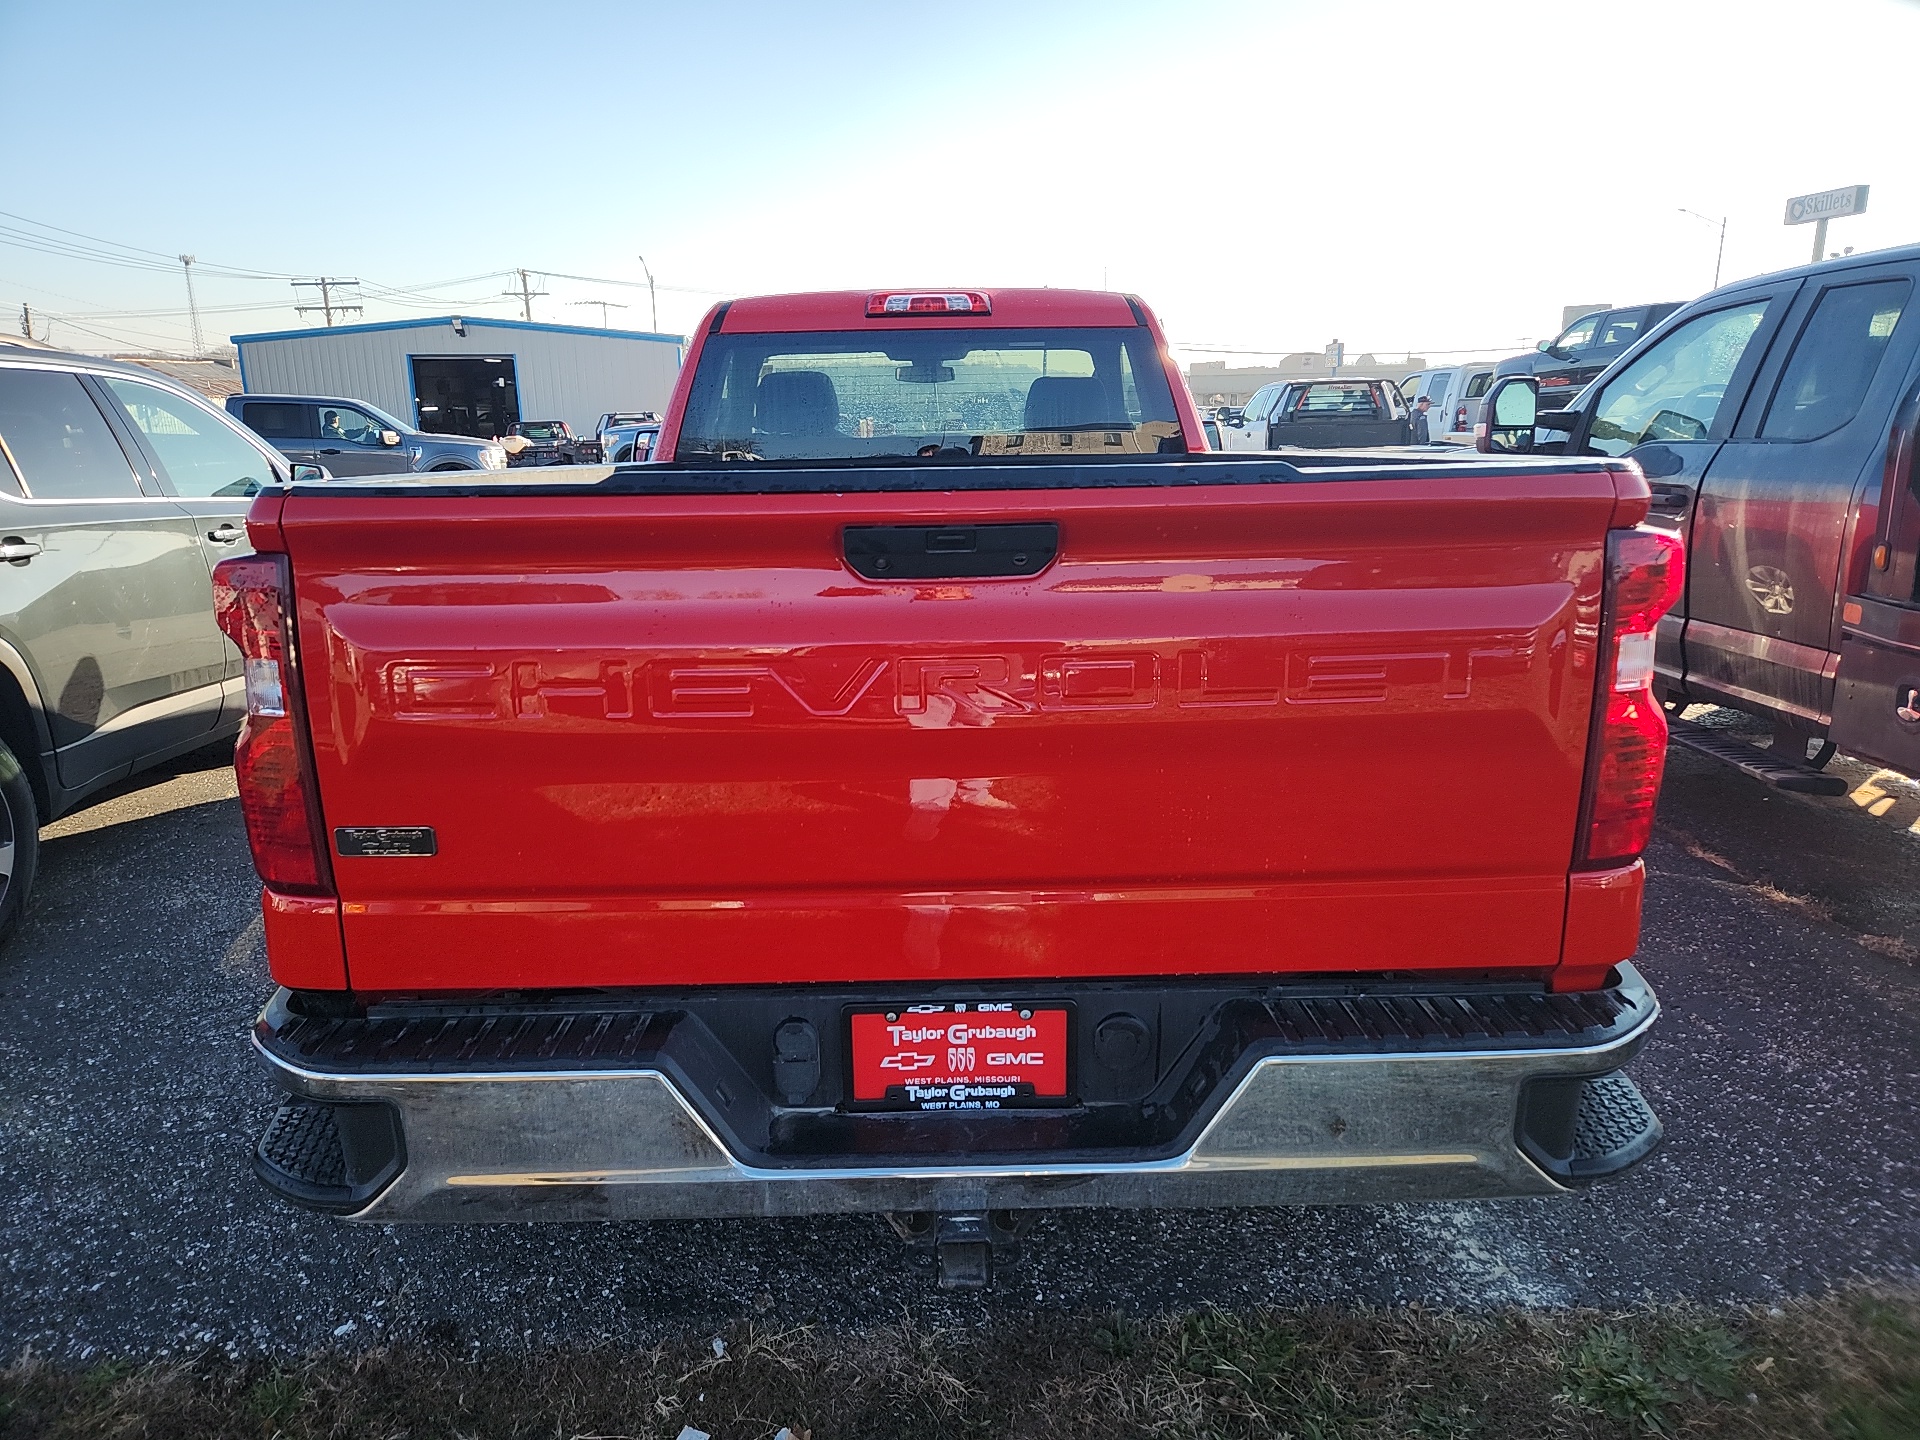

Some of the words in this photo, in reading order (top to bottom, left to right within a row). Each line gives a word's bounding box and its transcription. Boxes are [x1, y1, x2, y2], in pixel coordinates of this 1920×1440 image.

[1805, 193, 1853, 215] Skillets
[385, 648, 1518, 719] CHEVROLET
[977, 1003, 1013, 1012] GMC
[886, 1025, 945, 1047] Taylor
[947, 1023, 1037, 1045] Grubaugh
[986, 1052, 1044, 1065] GMC
[904, 1076, 932, 1085] WEST
[974, 1075, 1021, 1083] MISSOURI
[904, 1085, 948, 1102] Taylor
[949, 1084, 1016, 1101] Grubaugh
[920, 1102, 947, 1110] WEST
[948, 1101, 984, 1110] PLAINS,
[985, 1101, 1000, 1109] MO
